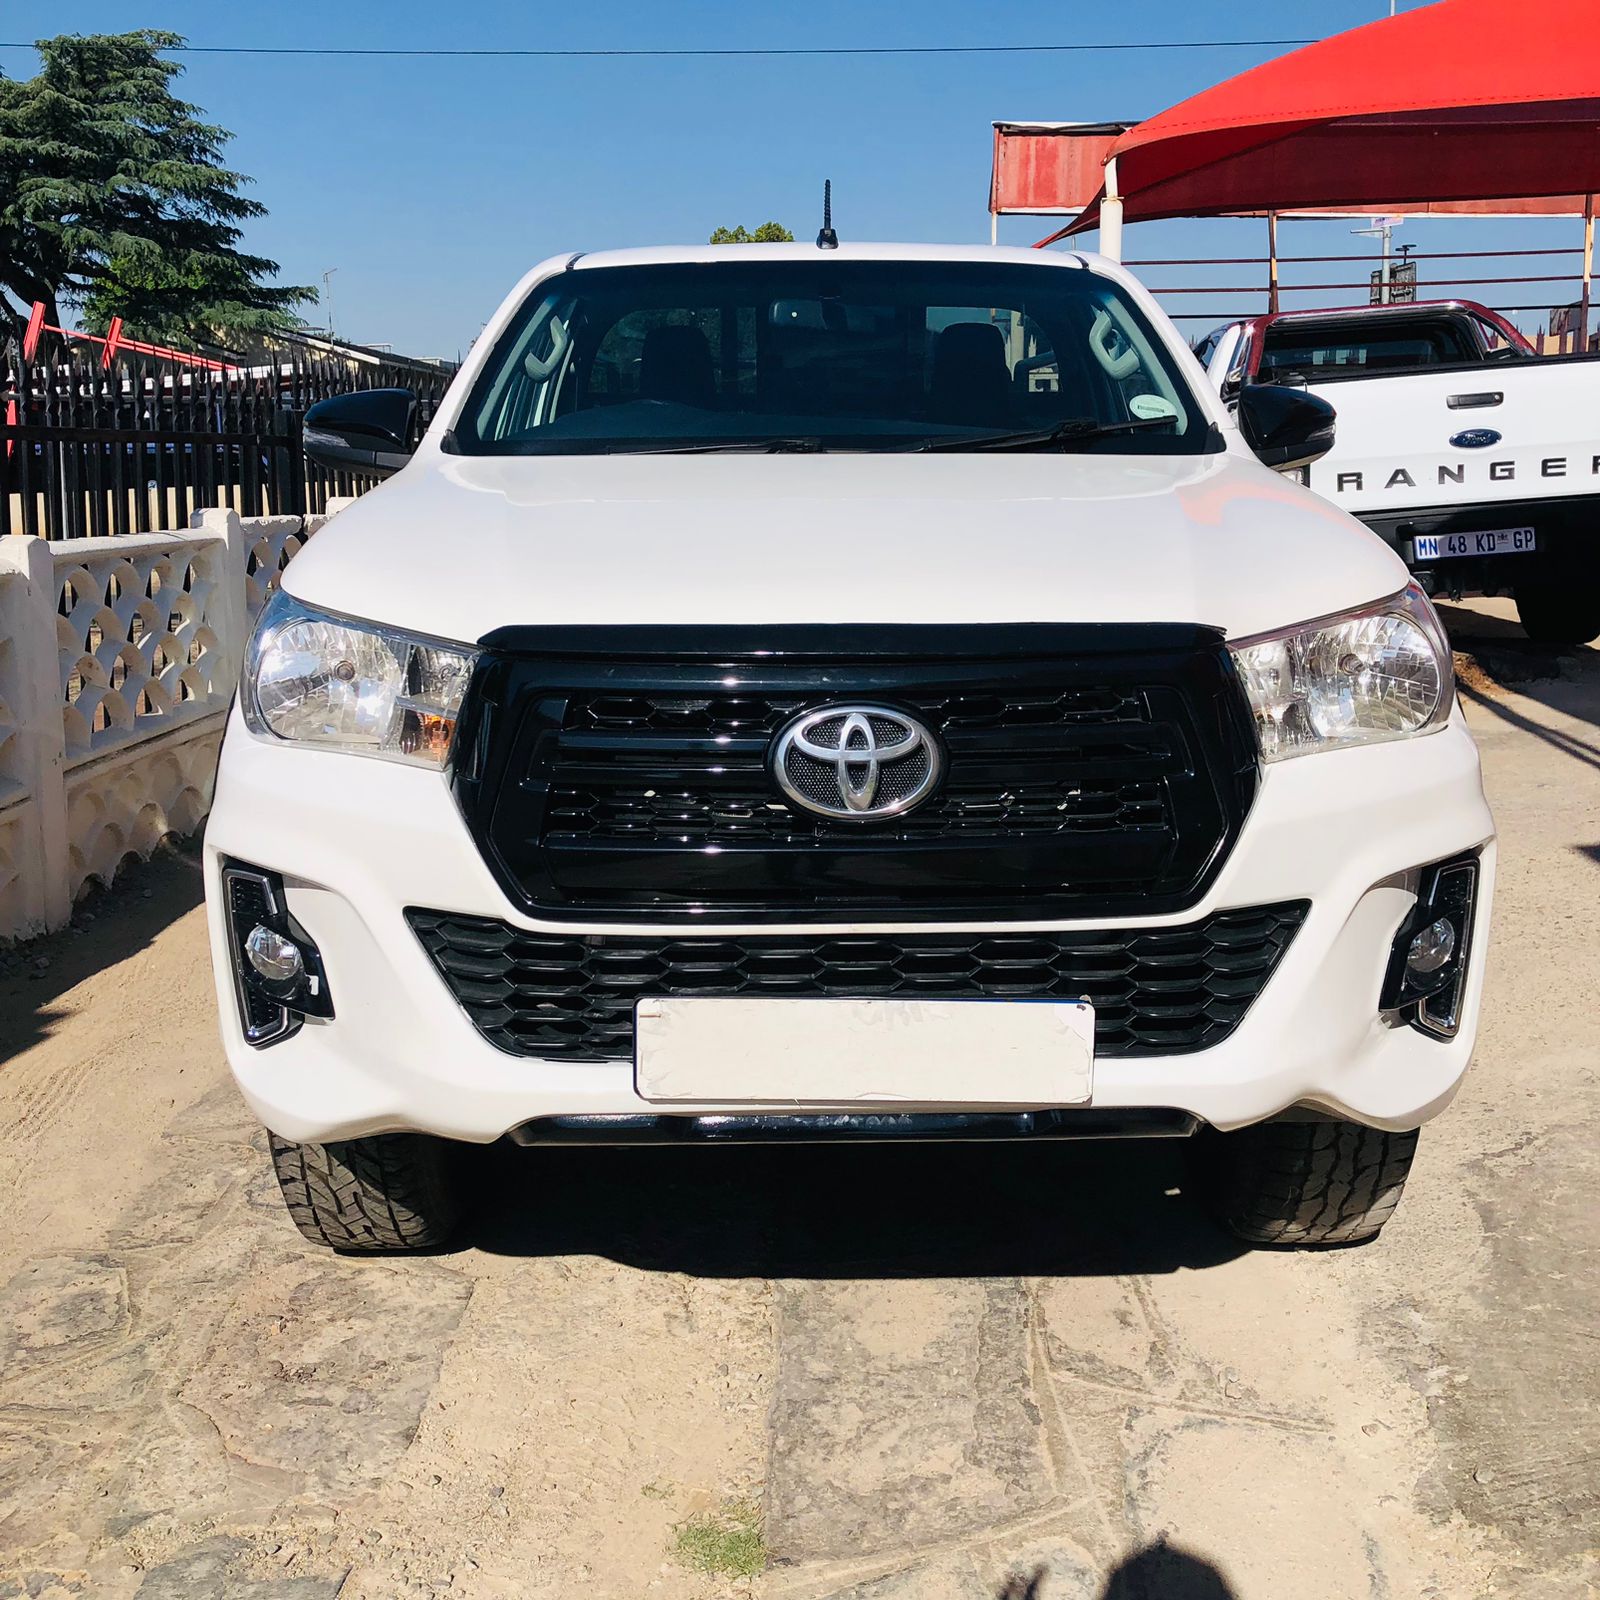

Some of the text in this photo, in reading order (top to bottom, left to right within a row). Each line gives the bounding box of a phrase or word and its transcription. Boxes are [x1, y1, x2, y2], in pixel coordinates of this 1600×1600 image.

[1419, 529, 1533, 556] MN 48 KD GP
